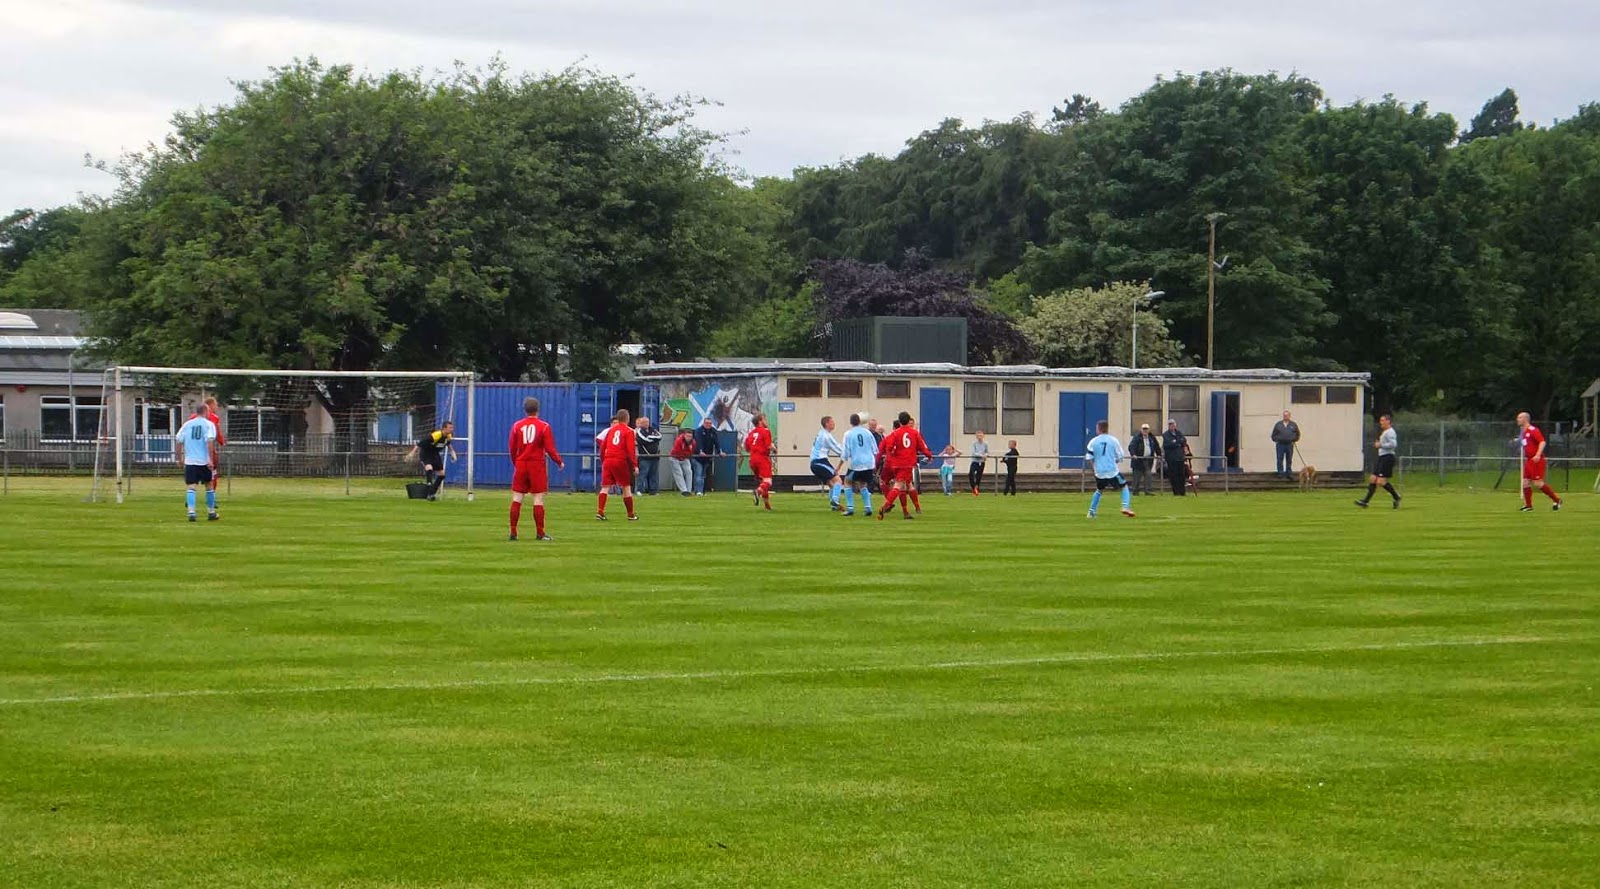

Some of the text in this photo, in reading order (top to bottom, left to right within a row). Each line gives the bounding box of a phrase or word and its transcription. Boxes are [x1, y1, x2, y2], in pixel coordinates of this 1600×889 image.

[192, 425, 201, 440] 10
[521, 425, 536, 444] 10
[613, 430, 620, 445] 8
[752, 433, 759, 445] 7
[858, 434, 864, 447] 9
[903, 433, 911, 448] 6
[1100, 443, 1107, 456] 7
